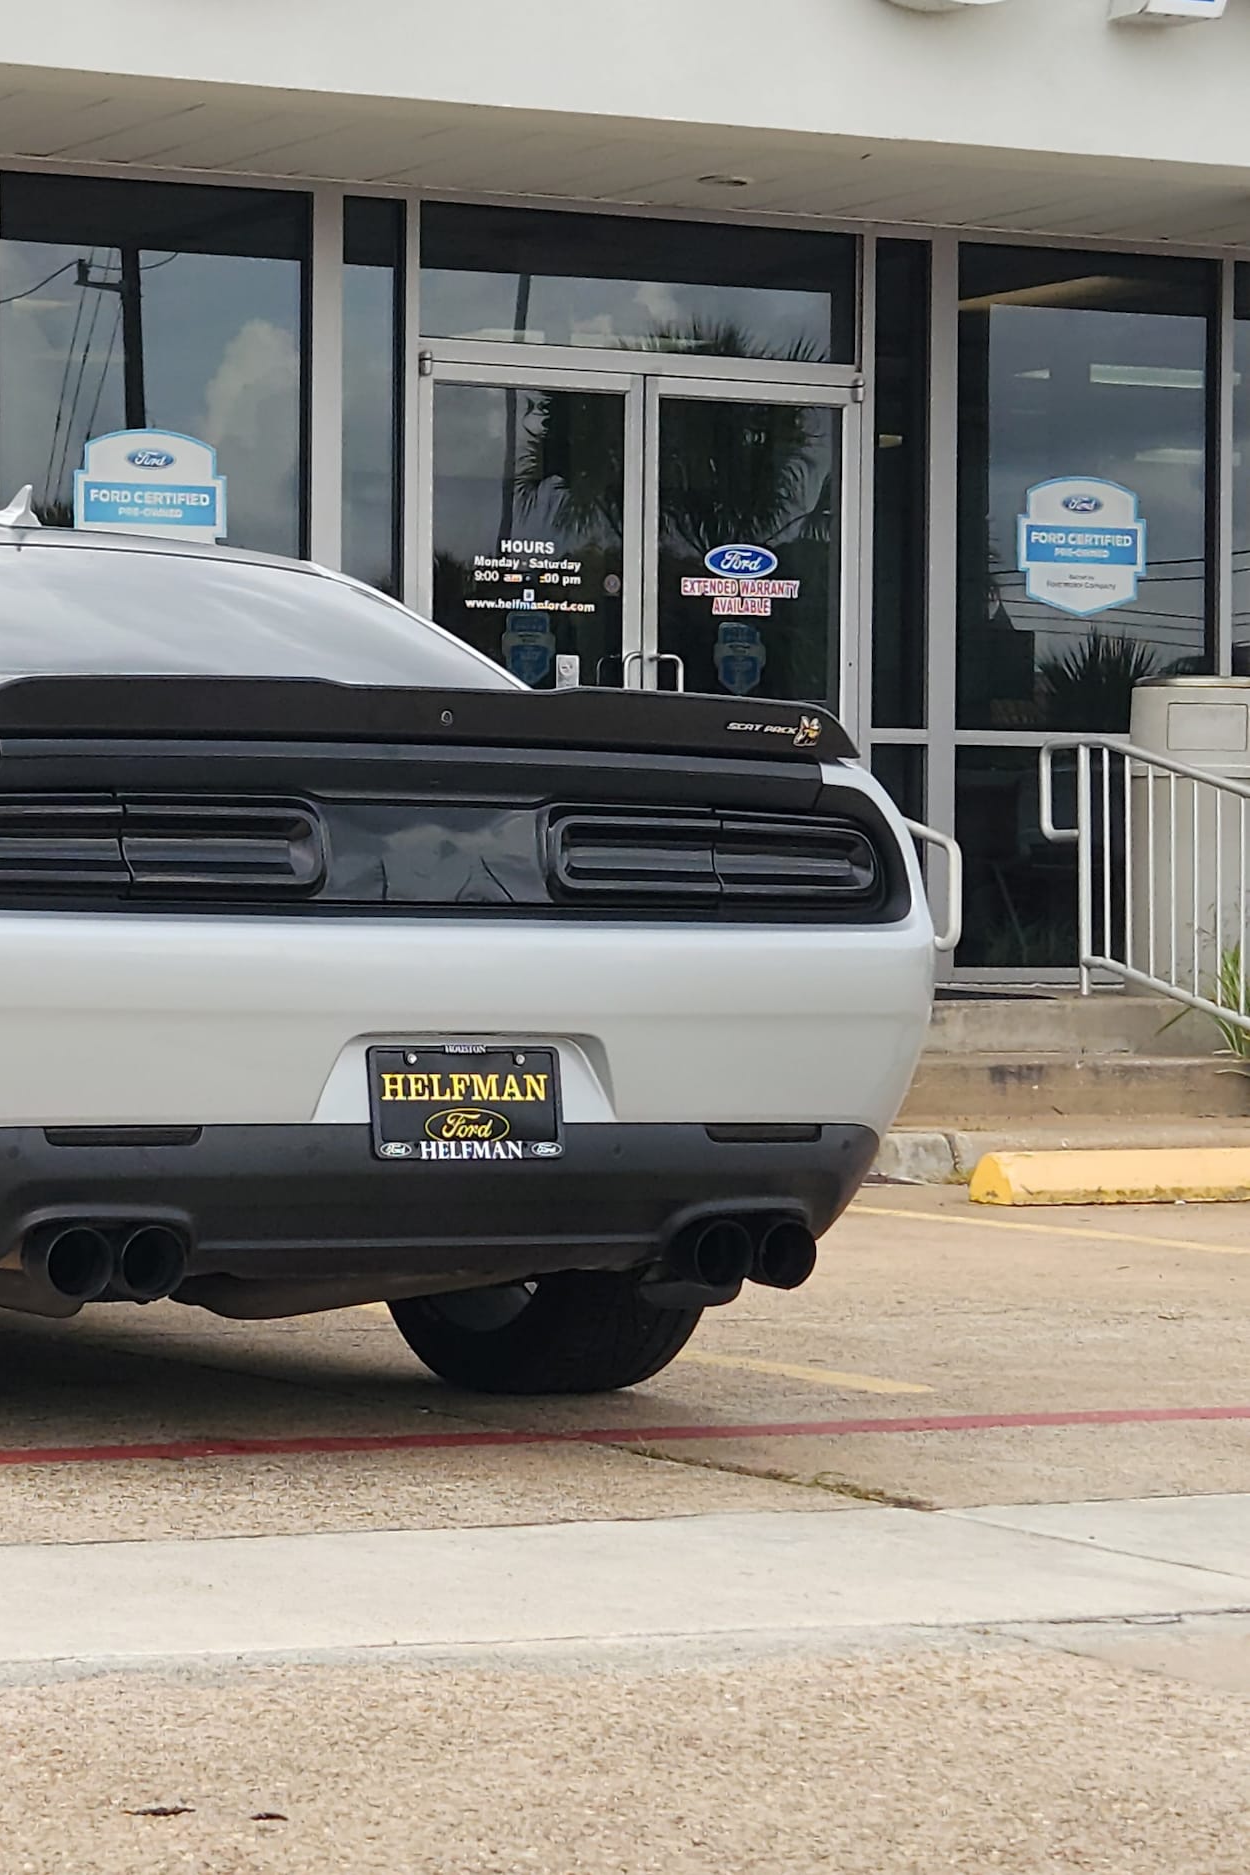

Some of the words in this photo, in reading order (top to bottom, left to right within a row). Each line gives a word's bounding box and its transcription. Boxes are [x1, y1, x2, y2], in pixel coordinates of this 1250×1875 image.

[133, 450, 167, 467] Ford
[89, 488, 131, 503] FORD
[133, 491, 210, 506] CERTIFIED
[500, 539, 555, 555] HOURS
[1031, 532, 1065, 544] FORD
[1067, 533, 1133, 547] CERTIFIED
[474, 555, 520, 569] Monday
[528, 557, 581, 572] Saturday
[720, 550, 762, 571] Ford
[474, 570, 500, 582] 9:00
[562, 574, 581, 586] pm
[681, 577, 738, 595] EXTENDED
[739, 579, 800, 598] WARRANTY
[465, 598, 596, 613] www.helfmanford.com
[712, 597, 771, 616] AVAILABLE
[727, 722, 763, 731] SCAT
[764, 725, 798, 734] PACK
[444, 1044, 487, 1054] HOUSTON
[380, 1073, 548, 1102] HELFMAN
[441, 1112, 493, 1139] Ford
[419, 1140, 523, 1161] HELFMAN
